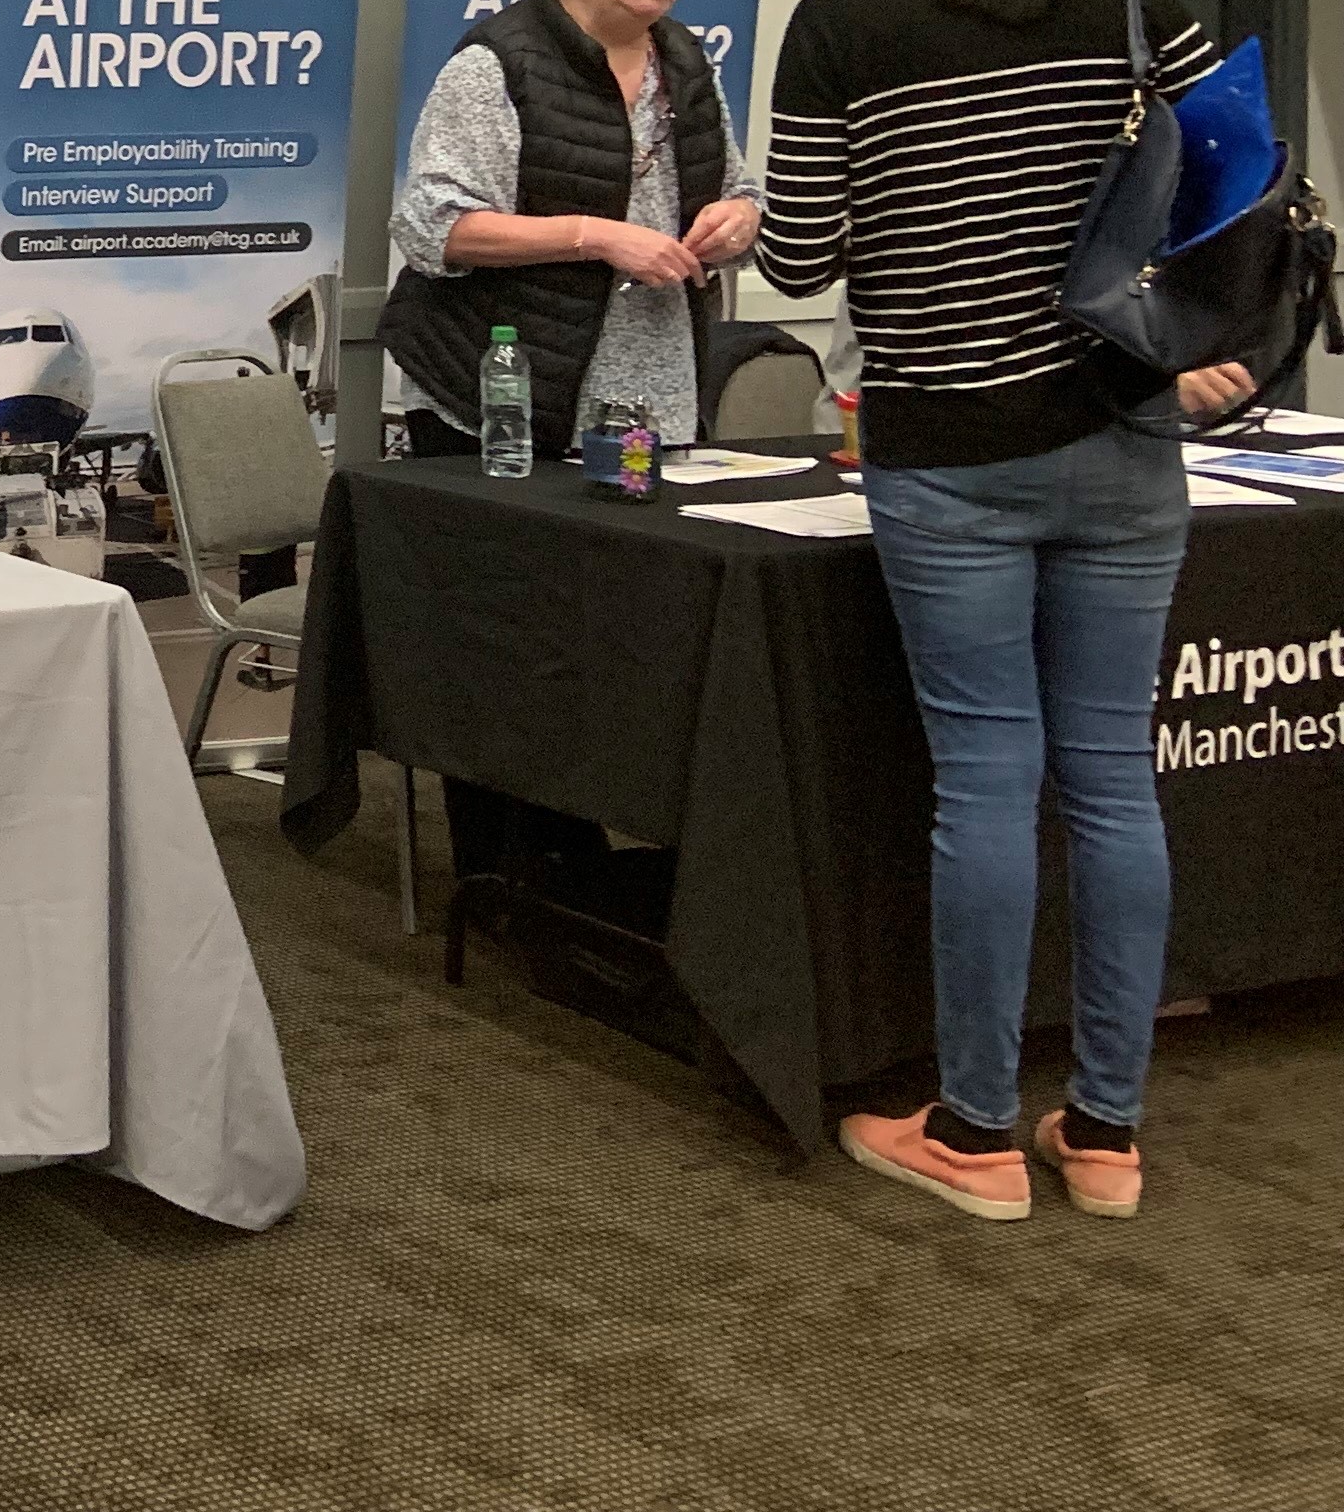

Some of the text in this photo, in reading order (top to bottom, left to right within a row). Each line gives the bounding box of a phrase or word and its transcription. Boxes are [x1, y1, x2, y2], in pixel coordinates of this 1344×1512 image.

[18, 29, 325, 90] AIRPORT?
[22, 137, 299, 166] Pre Employability Training
[21, 181, 214, 208] Interview Support
[18, 229, 301, 255] Email: airport.academy@tcg.ac.uk
[1171, 627, 1344, 705] Airport
